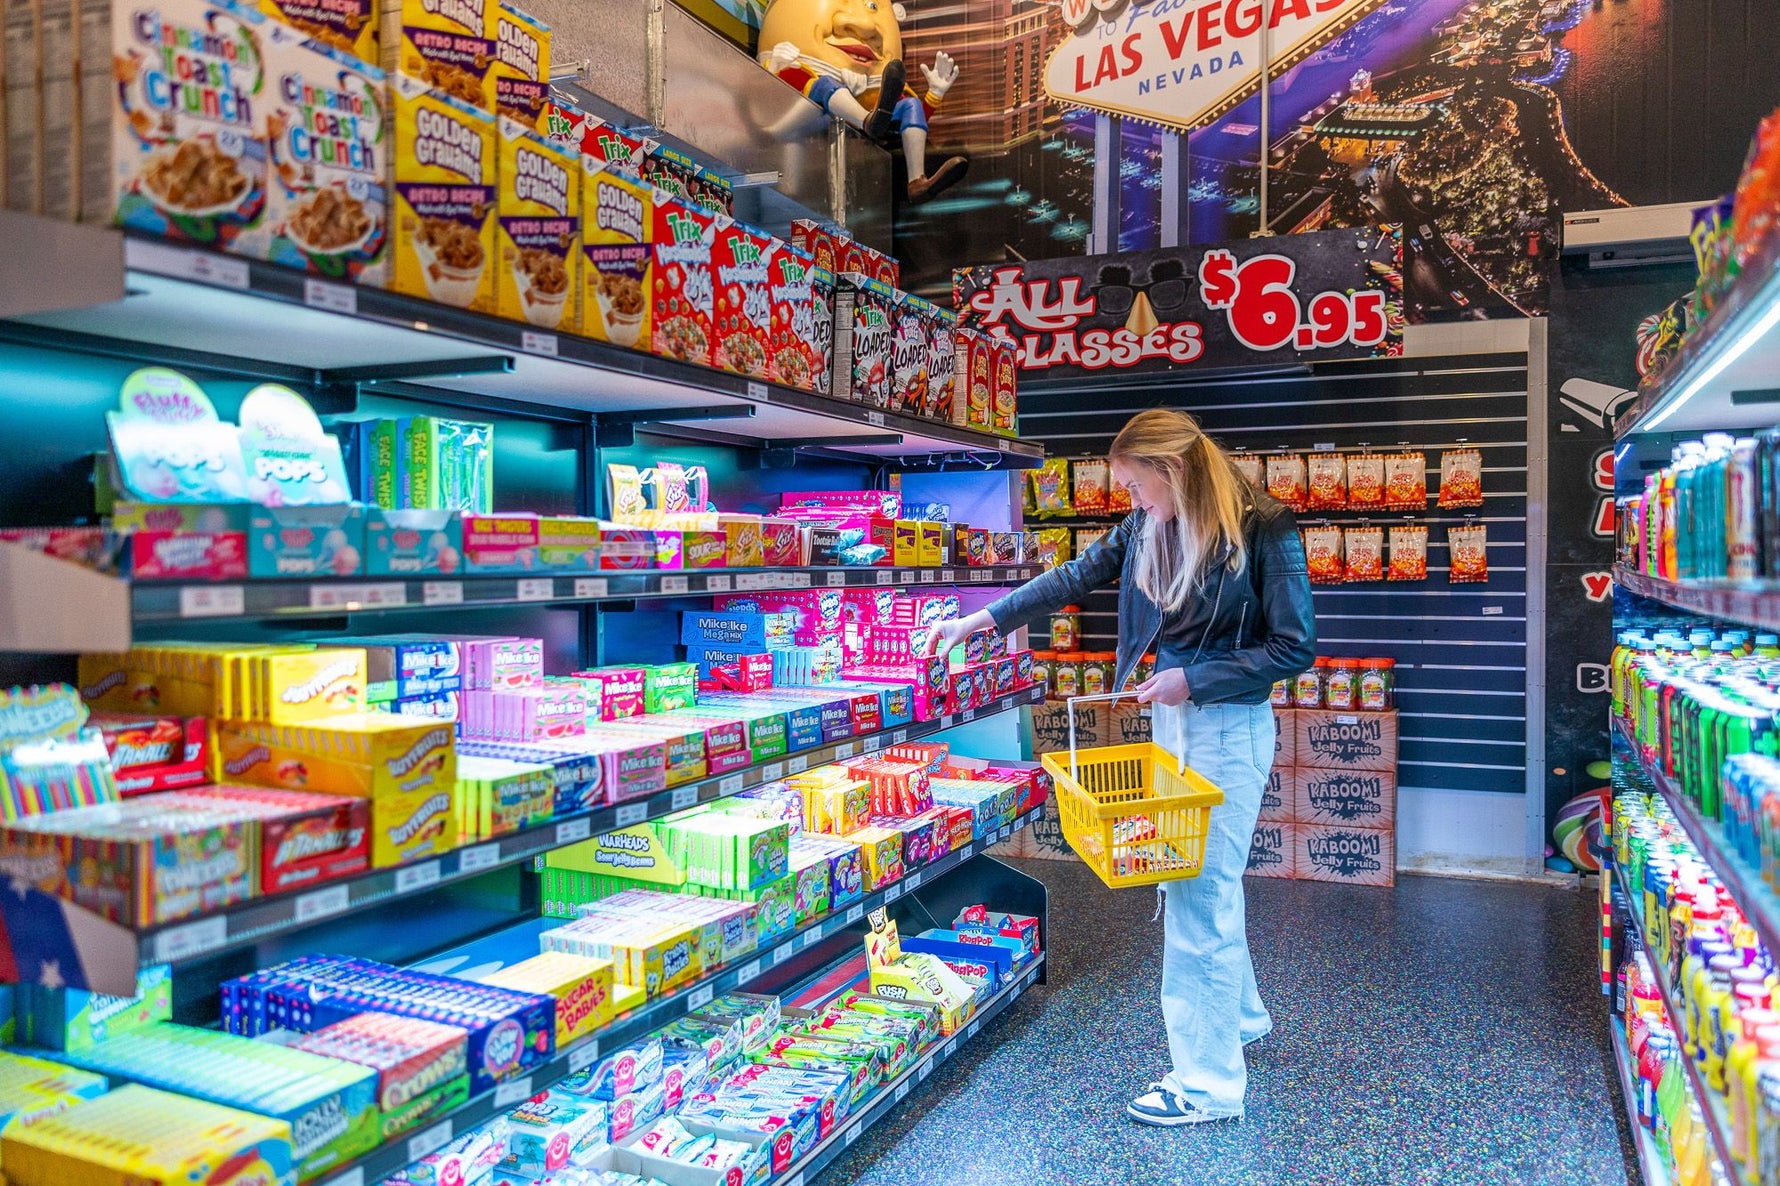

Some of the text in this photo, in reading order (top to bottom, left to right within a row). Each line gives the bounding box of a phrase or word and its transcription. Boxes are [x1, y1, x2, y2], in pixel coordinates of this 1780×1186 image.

[1097, 21, 1117, 40] TO
[1074, 32, 1143, 94] LAS
[1159, 0, 1348, 61] VEGA
[1138, 50, 1244, 96] NEVADA
[548, 107, 572, 137] rix
[599, 133, 632, 164] Trix
[653, 172, 683, 197] Trix
[666, 210, 703, 242] Trix
[727, 234, 761, 265] Trix
[778, 255, 806, 283] Trix
[972, 248, 1387, 352] ALL $6.95
[862, 304, 884, 327] Trix
[856, 331, 891, 359] LOADED
[894, 344, 927, 370] LOADED
[413, 432, 427, 465] FACE
[255, 458, 328, 484] POPS
[699, 618, 748, 632] Mike Ike
[704, 630, 729, 641] Mega
[403, 652, 434, 669] Mike
[496, 652, 523, 666] Mike
[704, 650, 732, 662] Mike
[605, 681, 643, 696] Mike Ike
[656, 675, 692, 688] Mike Ike
[536, 702, 565, 717] Mike
[822, 708, 847, 721] Mike Ike
[855, 703, 878, 714] Mike Ike
[754, 723, 784, 738] Mike Ike
[792, 715, 818, 729] Mike Ike
[1310, 719, 1381, 742] KABOOM!
[709, 732, 741, 748] Mike Ike
[1038, 729, 1064, 740] Jelly
[1313, 740, 1381, 755] Jelly Fruits
[621, 754, 663, 772] Mike Ike
[553, 768, 579, 784] Mike
[501, 780, 526, 796] Mike
[1310, 776, 1380, 799] KABOOM!
[1262, 797, 1281, 808] uits
[1313, 798, 1381, 812] Jelly Fruits
[599, 833, 650, 851] WARHEADS
[1309, 832, 1380, 856] KABOOM!
[596, 850, 654, 867] Sour Jelly Beans
[1251, 852, 1282, 863] Fruits
[1313, 855, 1380, 870] Jelly Fruits
[556, 978, 595, 1019] SUGAR
[877, 985, 907, 999] PUSH
[564, 985, 606, 1033] BABIES
